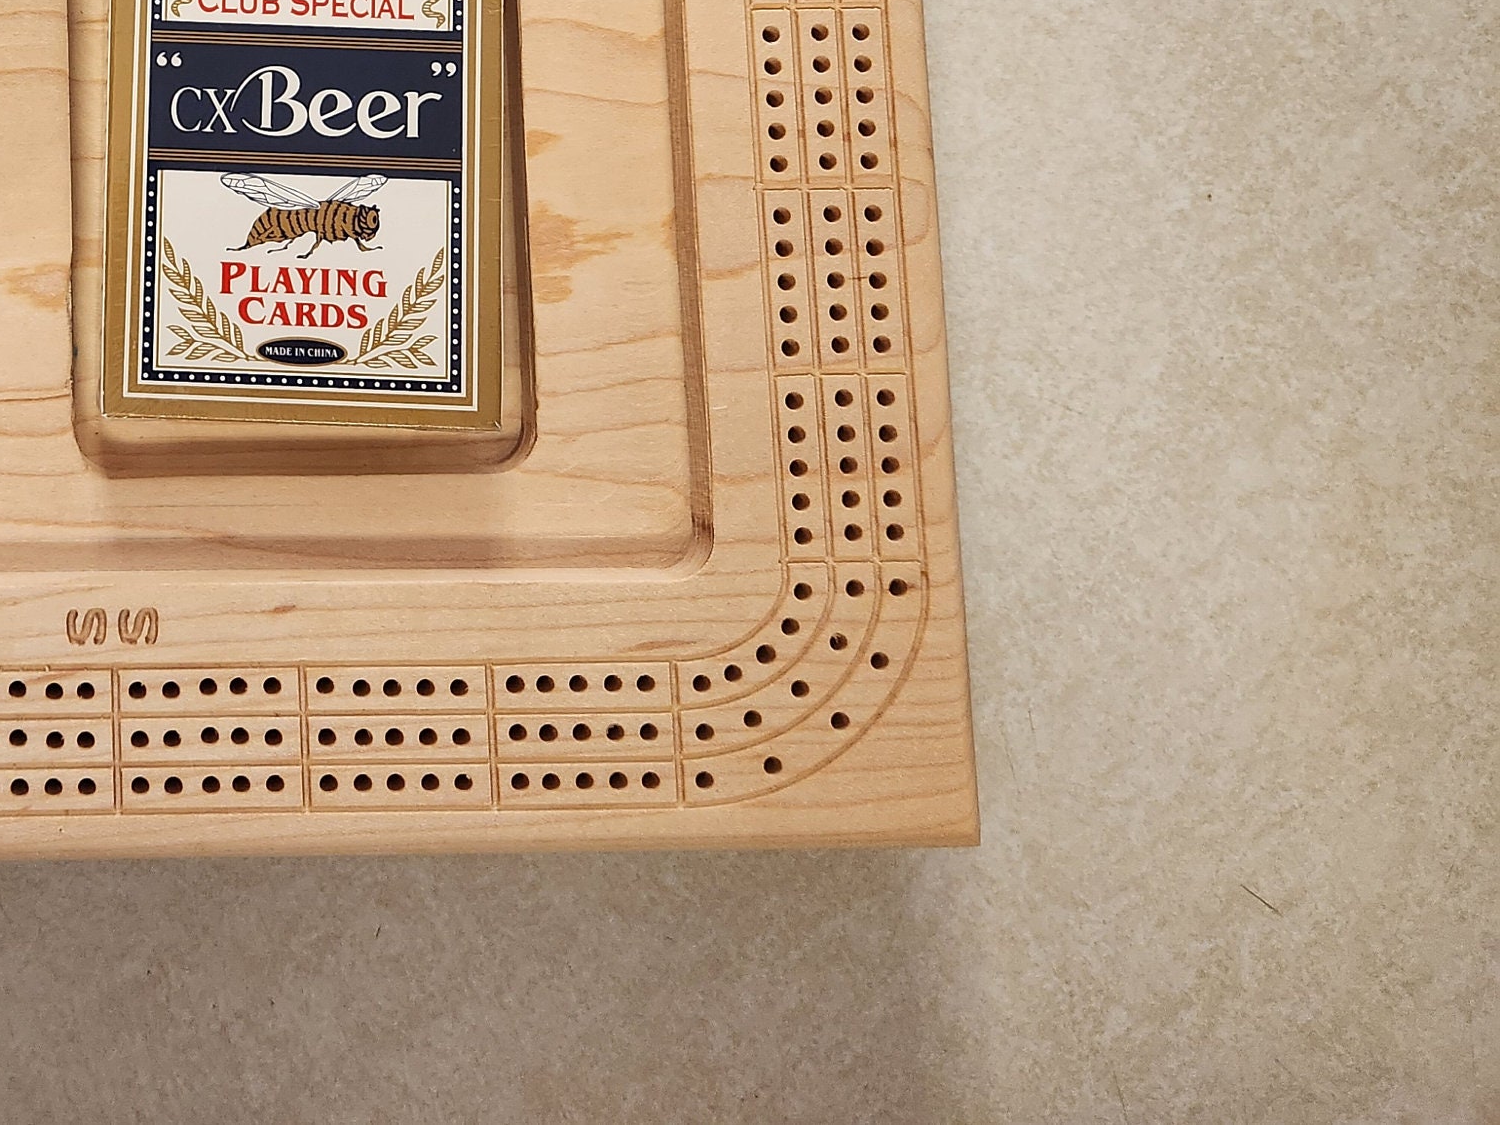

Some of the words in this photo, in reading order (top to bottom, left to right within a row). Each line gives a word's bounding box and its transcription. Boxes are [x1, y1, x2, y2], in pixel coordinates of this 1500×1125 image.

[219, 261, 388, 298] PLAYING
[238, 296, 369, 329] CARDS
[265, 346, 293, 357] MADE
[295, 347, 305, 357] IN
[307, 348, 338, 359] CHINA
